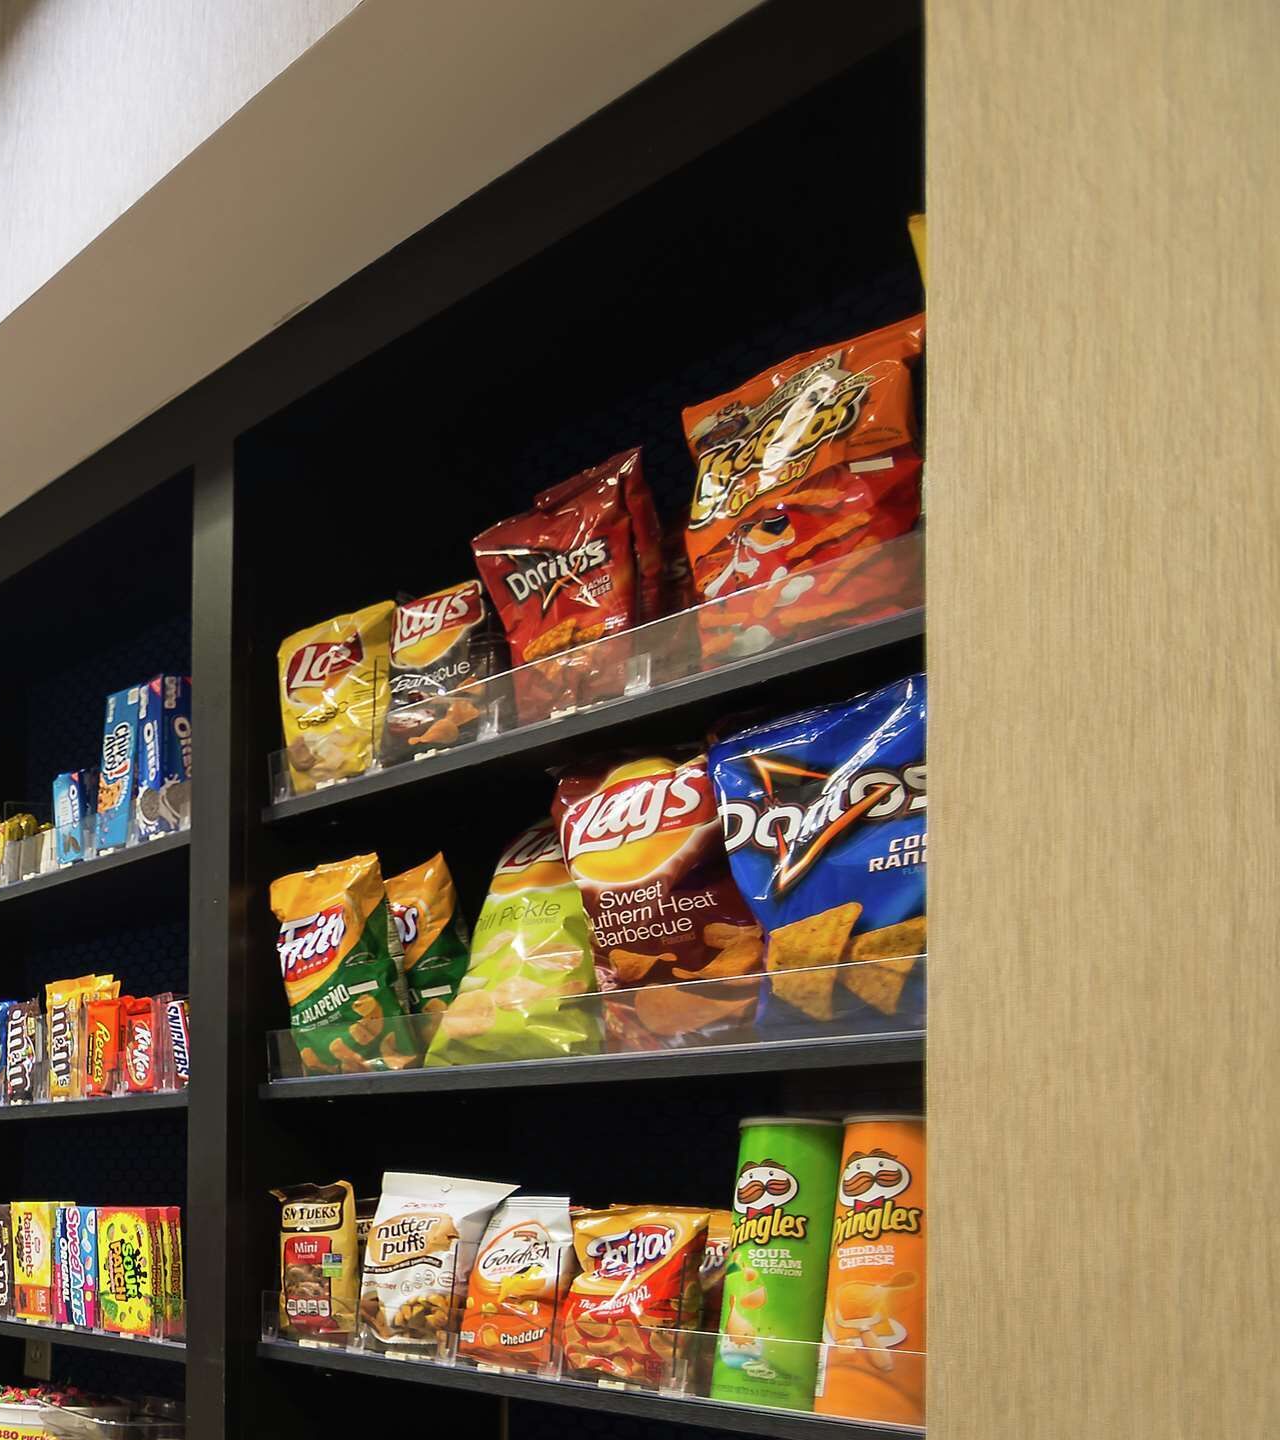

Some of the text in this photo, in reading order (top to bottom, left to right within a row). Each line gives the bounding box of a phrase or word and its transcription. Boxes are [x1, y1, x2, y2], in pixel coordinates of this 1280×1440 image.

[506, 539, 607, 602] Doritos
[393, 661, 471, 694] Barbecue
[113, 722, 129, 765] Chips
[589, 890, 719, 932] uthern Heat
[599, 880, 664, 911] Sweet
[500, 900, 561, 925] Pickle
[596, 915, 694, 949] Barbecue
[301, 983, 351, 1025] JALAPEÑO
[51, 1004, 69, 1088] m&m's
[168, 1005, 189, 1077] SNICKERS
[23, 1212, 34, 1278] Raisinets
[377, 1218, 437, 1239] nutter
[294, 1240, 318, 1254] Mini
[381, 1233, 426, 1262] puffs
[482, 1242, 551, 1270] Goldfish
[587, 1226, 676, 1276] Fritos
[748, 1249, 792, 1260] SOUR
[837, 1245, 895, 1258] CHEDDAR
[838, 1255, 895, 1270] CHEESE
[59, 1237, 70, 1303] ORIGINAL
[109, 1240, 126, 1302] PATCH
[120, 1242, 138, 1298] SOUR
[751, 1258, 802, 1270] CREAM
[500, 1327, 546, 1345] Cheddar
